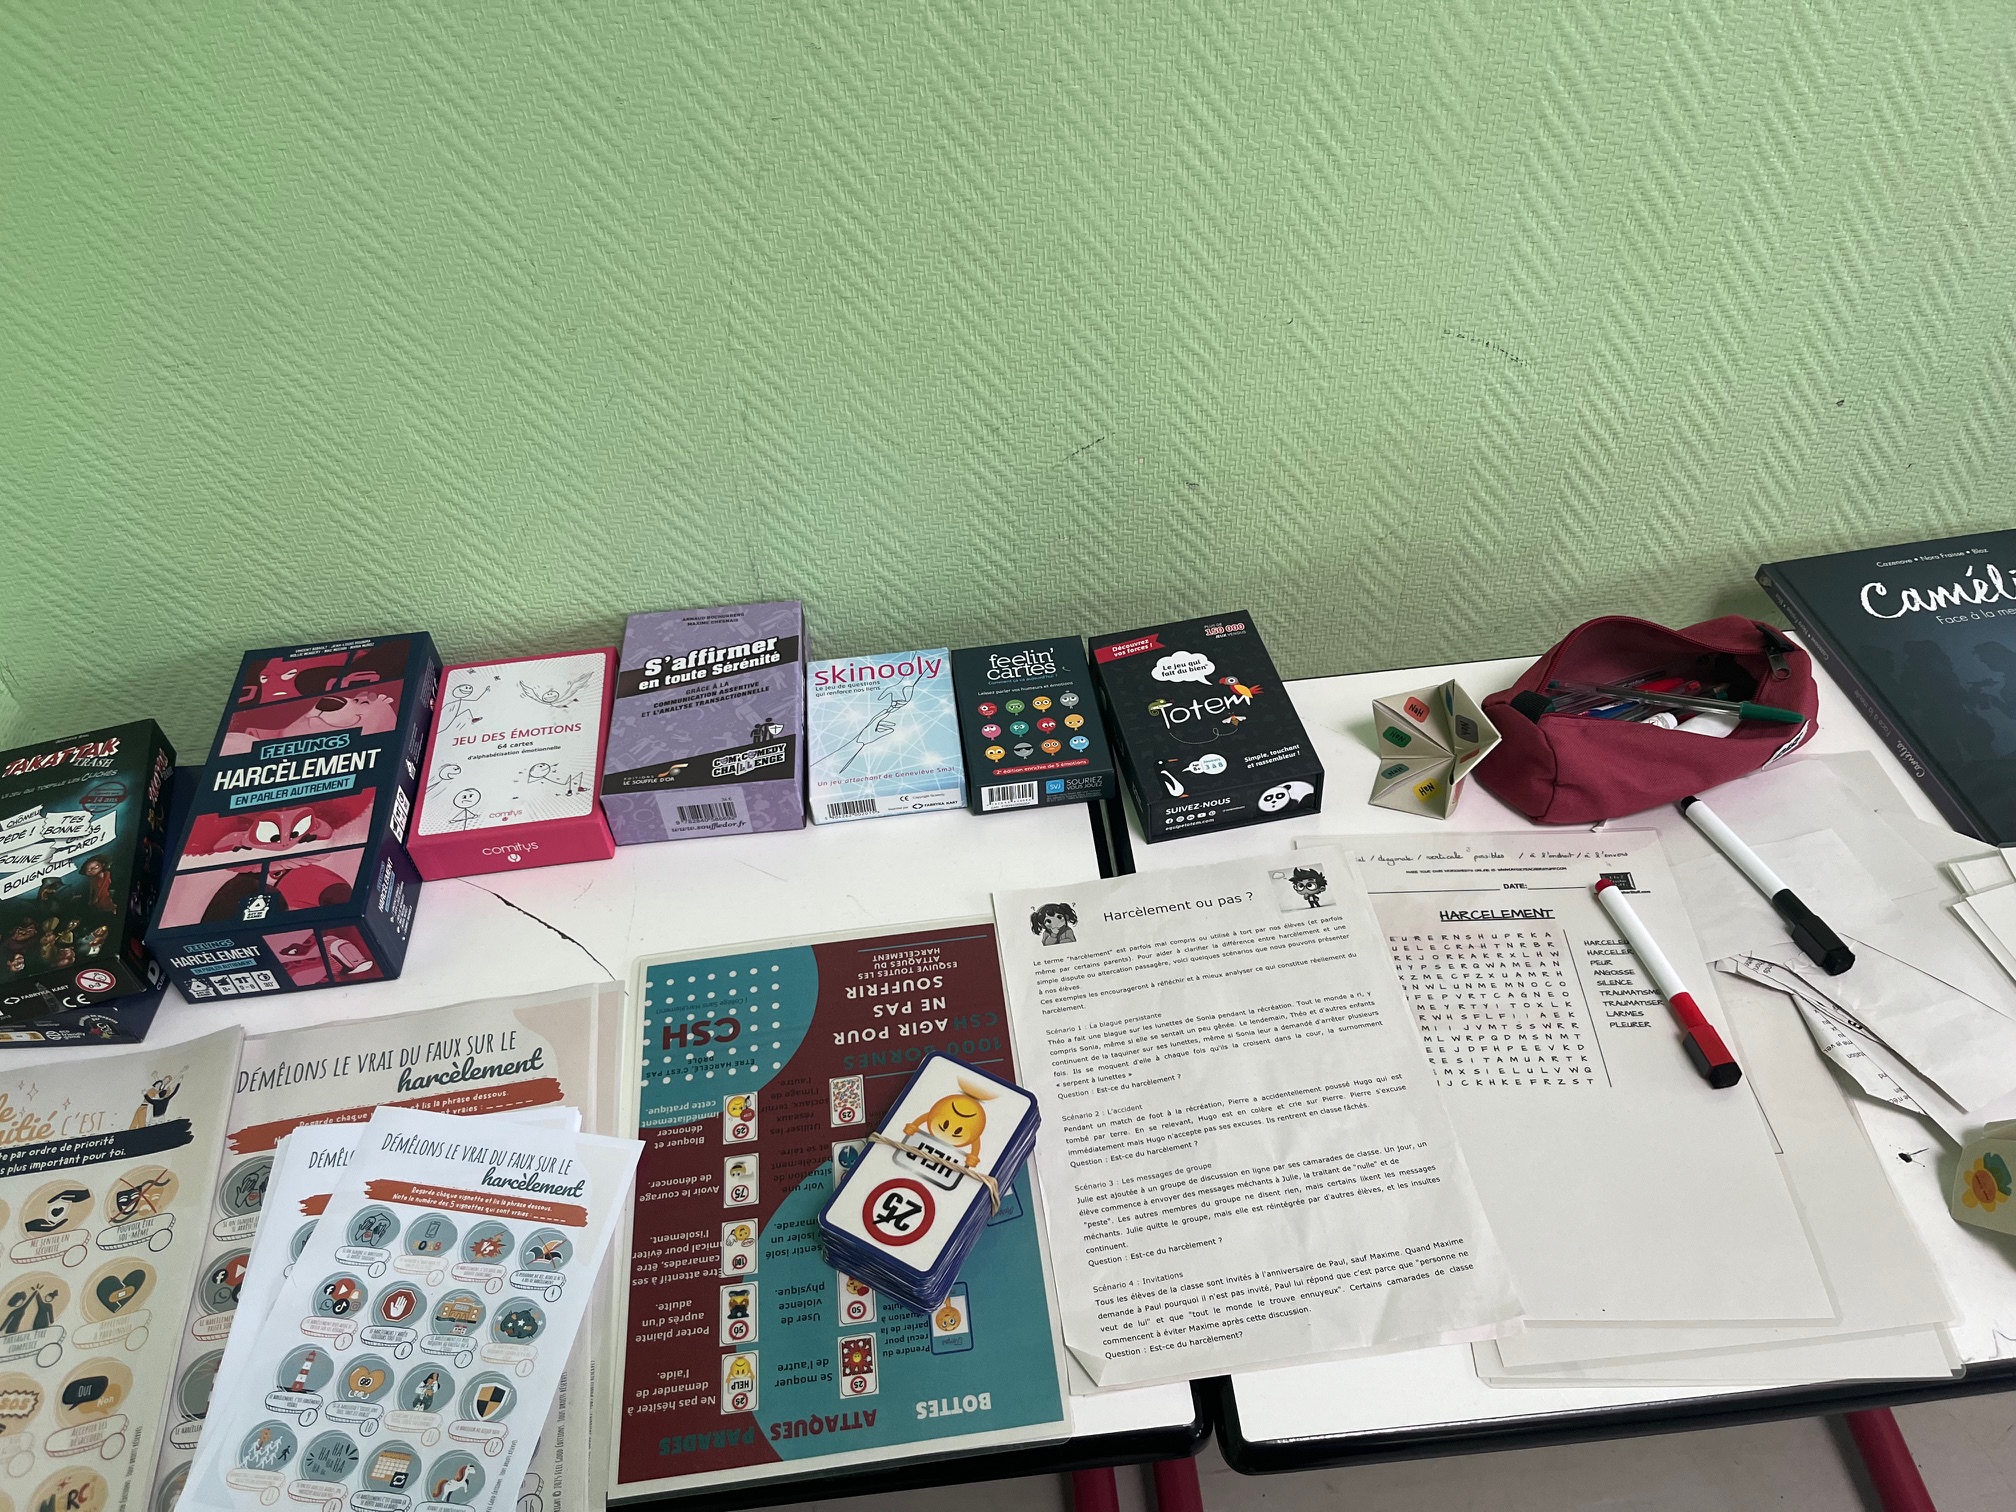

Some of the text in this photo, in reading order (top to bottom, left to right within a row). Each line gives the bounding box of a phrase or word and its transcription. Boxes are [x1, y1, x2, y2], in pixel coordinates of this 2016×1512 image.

[1936, 610, 1995, 624] Face la
[1205, 623, 1245, 636] 150 000
[1112, 639, 1149, 652] Découvrez
[1128, 645, 1148, 654] forces
[645, 637, 778, 677] S'affirmer
[989, 648, 1053, 668] feelin'
[639, 652, 780, 690] en toute Sérénité
[815, 656, 941, 686] skinooly
[987, 663, 1056, 680] cartes
[654, 682, 759, 708] COMMUNICATION ASSERTIVE
[686, 686, 710, 694] GRÂCE
[653, 703, 692, 715] L'ANALYSE
[696, 686, 770, 706] TRANSACTIONNELLE
[1159, 694, 1250, 729] Totem
[453, 723, 582, 747] JEU DES ÉMOTIONS
[260, 734, 350, 759] FEELINGS
[468, 745, 561, 760] d'alphabétisation émotionnelle
[1244, 744, 1300, 763] Simple, touchant
[2, 737, 120, 778] TAKATTAK
[73, 758, 114, 767] TRASH
[1256, 753, 1296, 766] rassembleur
[214, 749, 381, 791] HARCÈLEMENT
[845, 775, 881, 783] attachant
[896, 768, 934, 778] Geneviève
[1067, 776, 1102, 786] SOURIEZ
[235, 778, 350, 806] EN PARLER AUTREMENT
[489, 809, 523, 819] comitys
[1166, 798, 1231, 815] SUIVEZ-NOUS
[43, 825, 84, 834] BONNE
[672, 821, 746, 832] www.souffledor.fr
[1165, 819, 1215, 830] equipetotem.com
[482, 842, 539, 856] comitys
[1103, 895, 1242, 922] Harcèlement ou pas
[1439, 907, 1555, 920] HARCELEMENT
[1222, 939, 1254, 947] différence
[1279, 929, 1320, 939] harcèlement
[170, 946, 261, 968] HARCÈLEMENT
[873, 948, 940, 962] HARCÈLEMENT
[891, 956, 940, 967] ATTAQUES
[878, 966, 914, 977] TOUTES
[917, 961, 958, 973] ESQUIVE
[845, 976, 943, 999] SOUFFRIR
[873, 997, 946, 1018] NE PAS
[954, 1012, 998, 1030] CSH
[662, 1017, 741, 1050] CSH
[833, 1018, 948, 1045] AGIR POUR
[237, 1031, 517, 1093] DÉMÊLONS LE VRAI DU FAUX SUR LE
[398, 1047, 544, 1093] harcèlement
[641, 1111, 719, 1127] immédiatement
[657, 1126, 703, 1136] dénoncer
[10, 1136, 114, 1161] par ordre de priorité
[382, 1133, 573, 1175] DÉMÊLONS LE VRAI DU FAUX SUR LE
[7, 1148, 126, 1175] plus important pour toi.
[481, 1167, 585, 1198] harcèlement
[775, 1281, 825, 1296] physique.
[1093, 1272, 1183, 1293] Scénario Invitations
[778, 1298, 822, 1310] violence
[636, 1326, 709, 1343] Porter plainte
[1105, 1348, 1141, 1360] Question
[1150, 1344, 1175, 1352] Est-ce
[1189, 1331, 1242, 1346] harcèlement?
[657, 1369, 690, 1379] l'aide.
[775, 1372, 833, 1388] Se moquer
[78, 1385, 93, 1398] OUI
[636, 1381, 709, 1398] demander de
[731, 1380, 750, 1390] HELP
[97, 1396, 114, 1407] Non
[916, 1392, 992, 1420] BOTTES
[770, 1409, 877, 1441] ATTAQUES
[659, 1426, 755, 1456] PARADES
